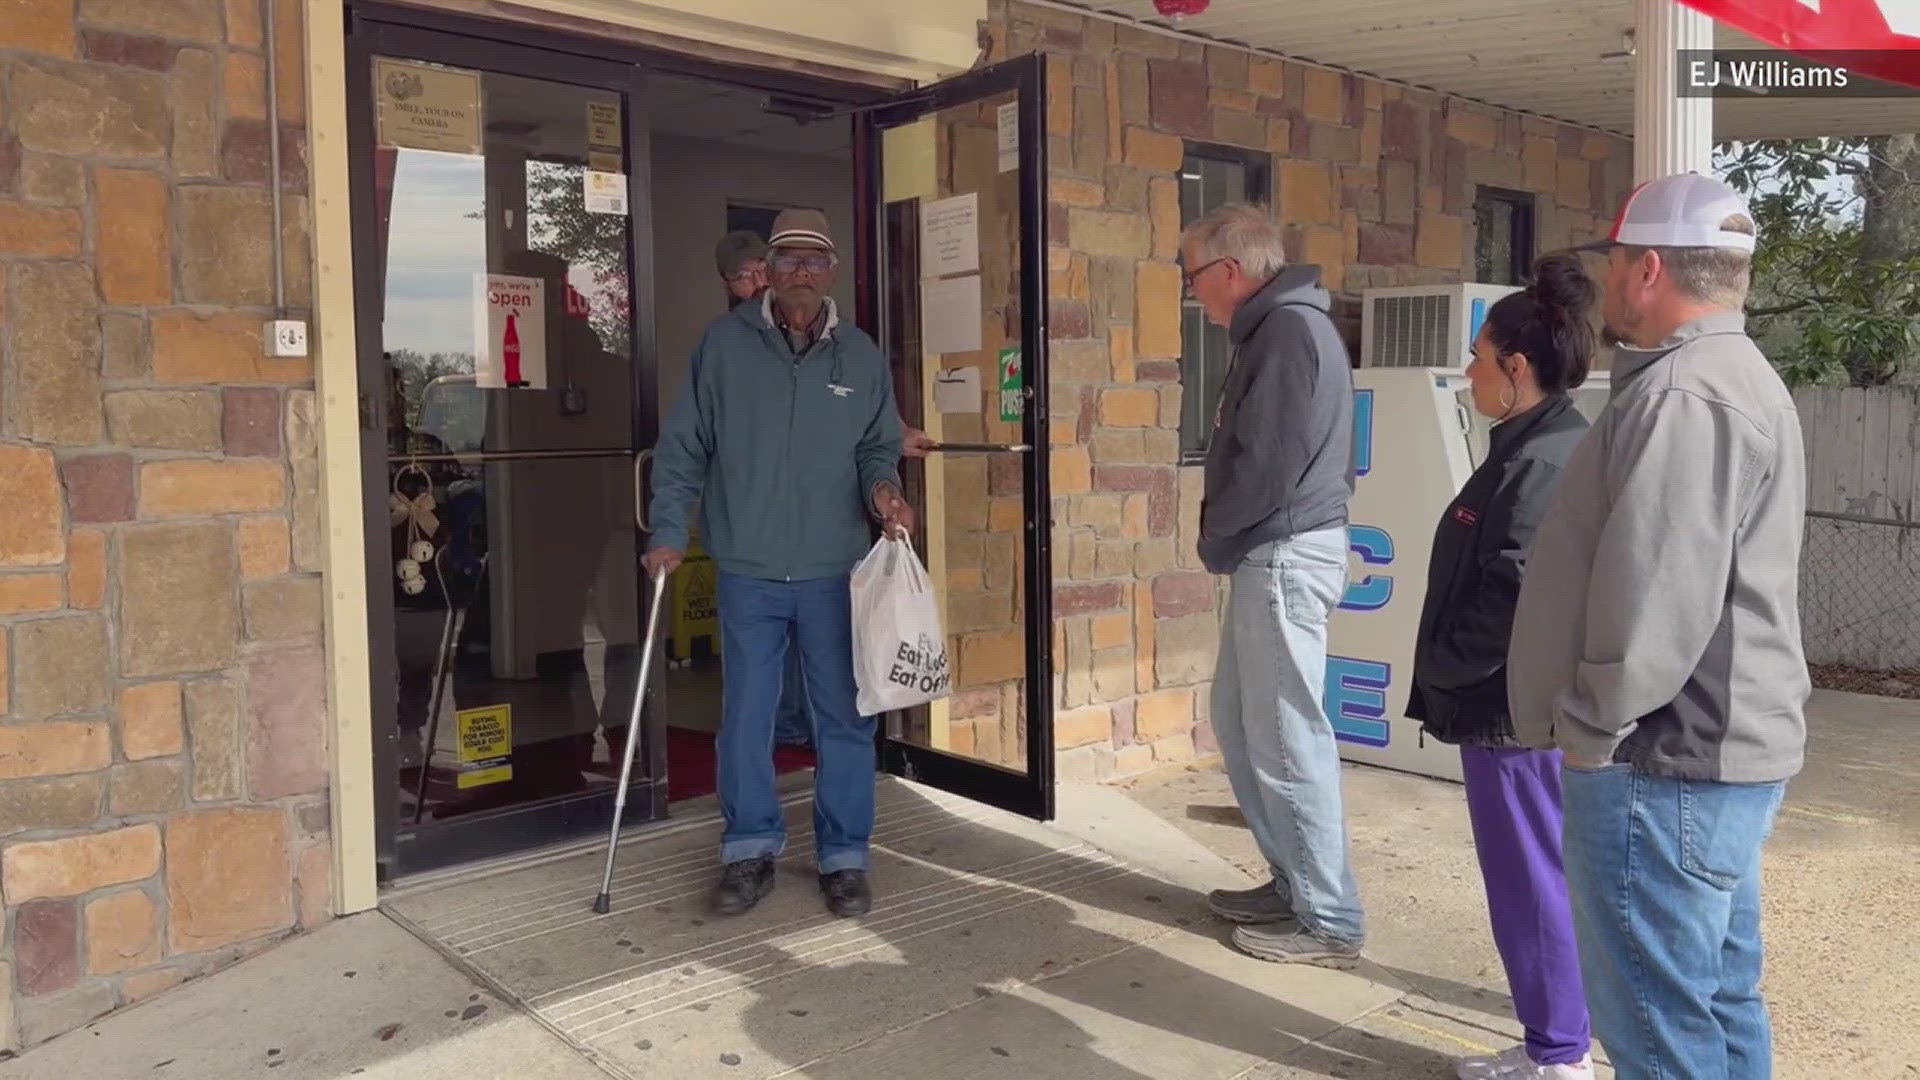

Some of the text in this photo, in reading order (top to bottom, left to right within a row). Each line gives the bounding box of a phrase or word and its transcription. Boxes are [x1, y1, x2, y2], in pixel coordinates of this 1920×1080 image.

[451, 110, 465, 119] ON
[411, 116, 449, 129] CAMERA
[489, 292, 531, 308] open
[687, 597, 711, 609] WET
[897, 641, 922, 667] Eat
[889, 664, 918, 688] Eat
